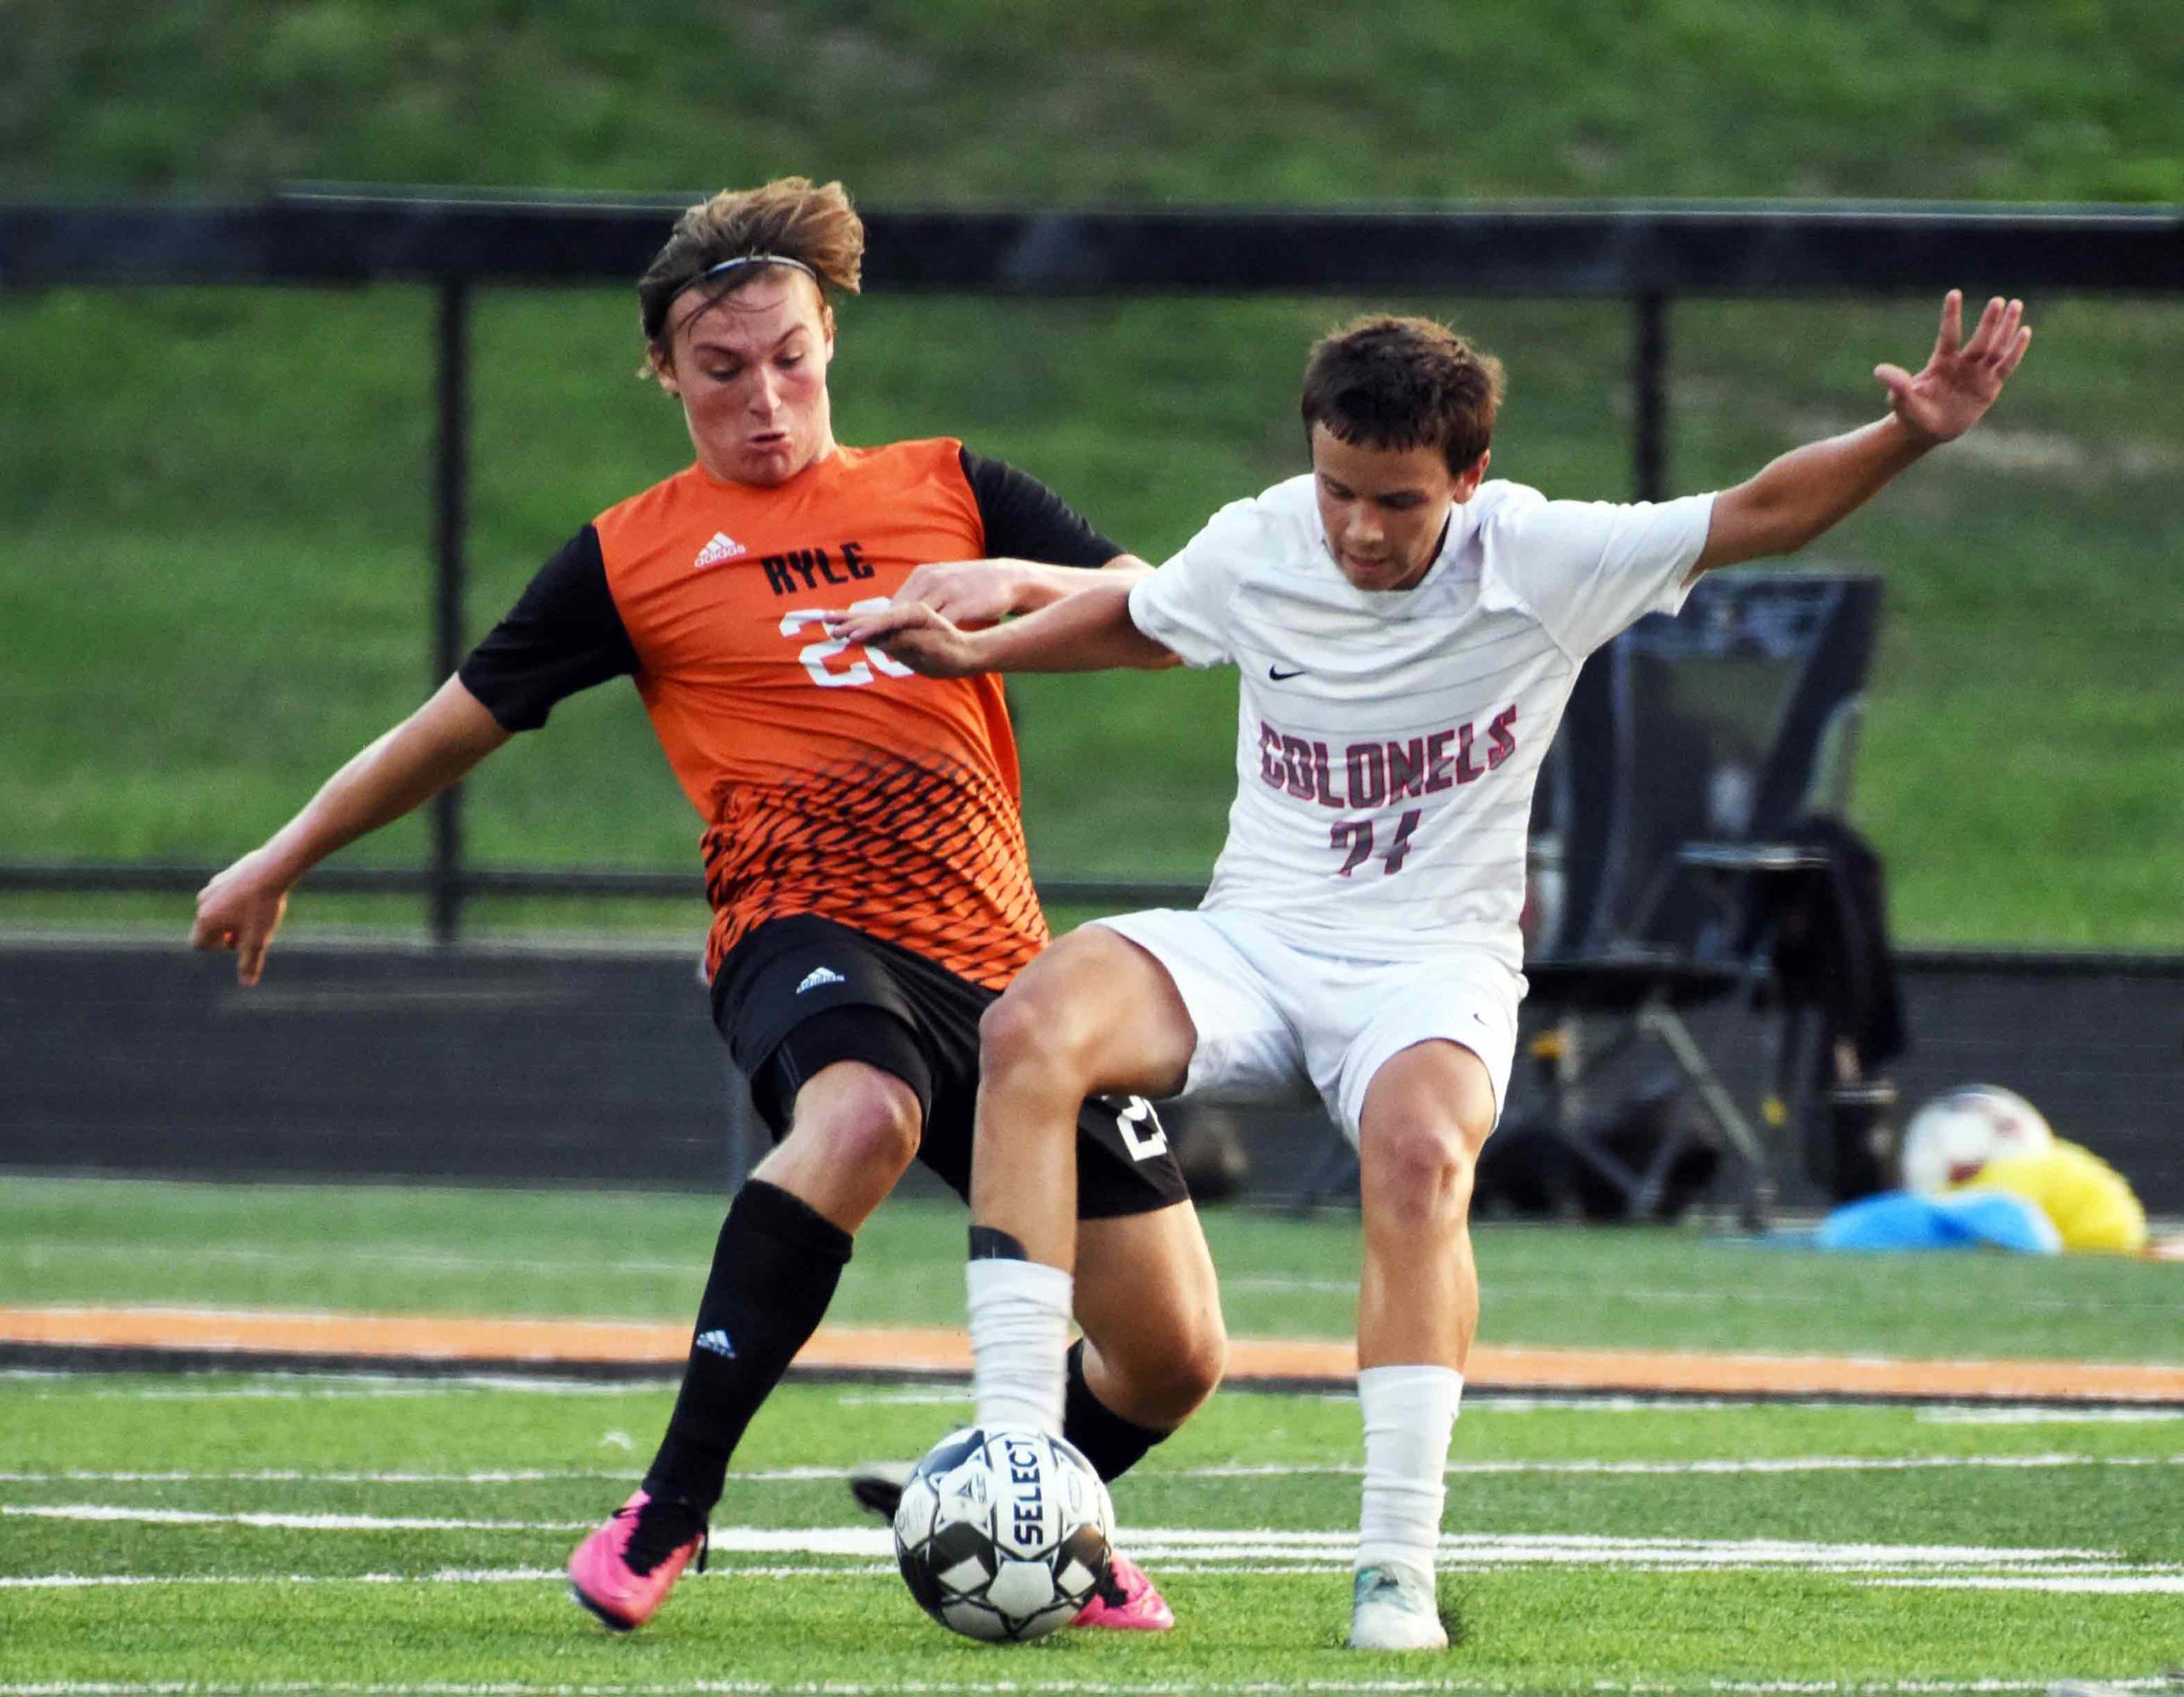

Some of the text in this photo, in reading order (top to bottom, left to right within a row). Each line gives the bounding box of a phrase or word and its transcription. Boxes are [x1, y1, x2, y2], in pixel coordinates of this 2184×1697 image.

[761, 542, 875, 596] RYLE
[1259, 703, 1519, 810] COLONELS
[1116, 1095, 1168, 1162] 2
[1005, 1440, 1044, 1546] SELECT
